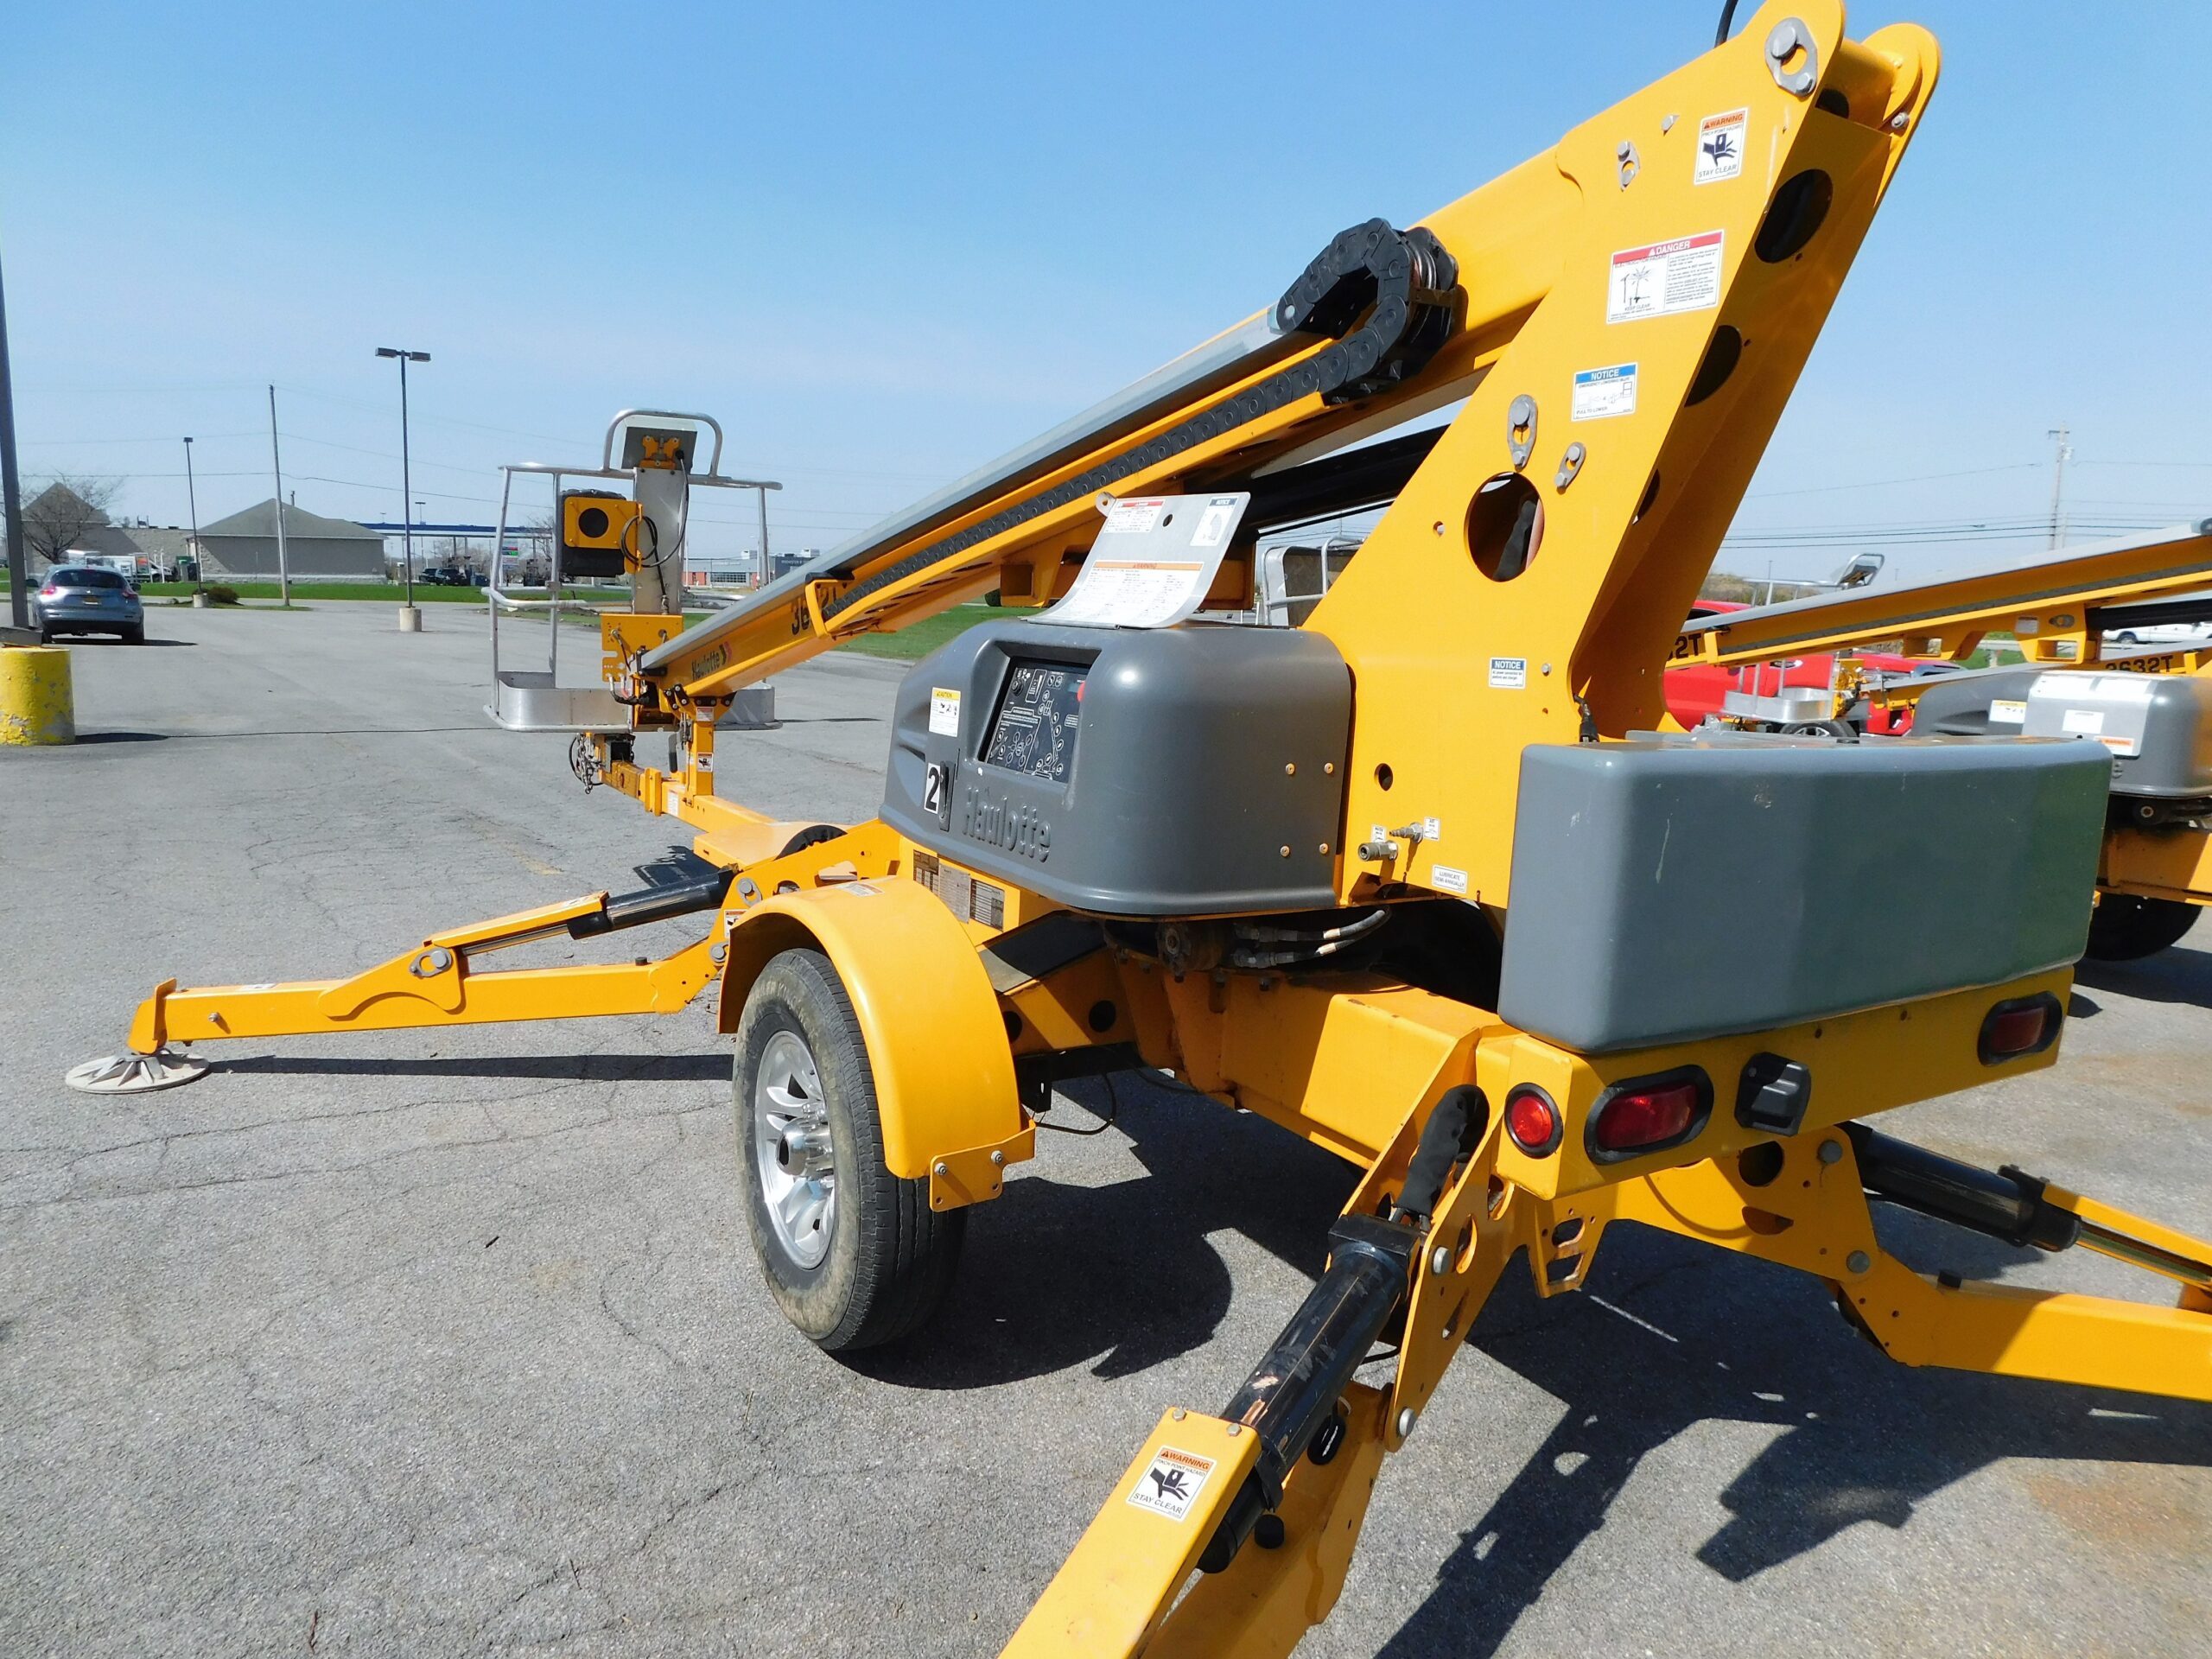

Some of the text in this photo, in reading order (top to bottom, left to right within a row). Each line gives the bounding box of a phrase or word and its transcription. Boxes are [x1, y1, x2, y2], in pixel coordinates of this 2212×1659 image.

[1710, 113, 1743, 127] WARNING
[1698, 164, 1738, 178] STAY CLEAR
[1656, 240, 1691, 255] DANGER
[1591, 368, 1619, 381] NOTICE
[1495, 660, 1522, 670] NOTICE
[962, 786, 1052, 863] Haulotte
[1169, 1452, 1210, 1470] WARNING
[1171, 1462, 1185, 1471] POINT
[1185, 1467, 1206, 1477] HAZARD
[1133, 1492, 1183, 1514] STAY CLEAR
